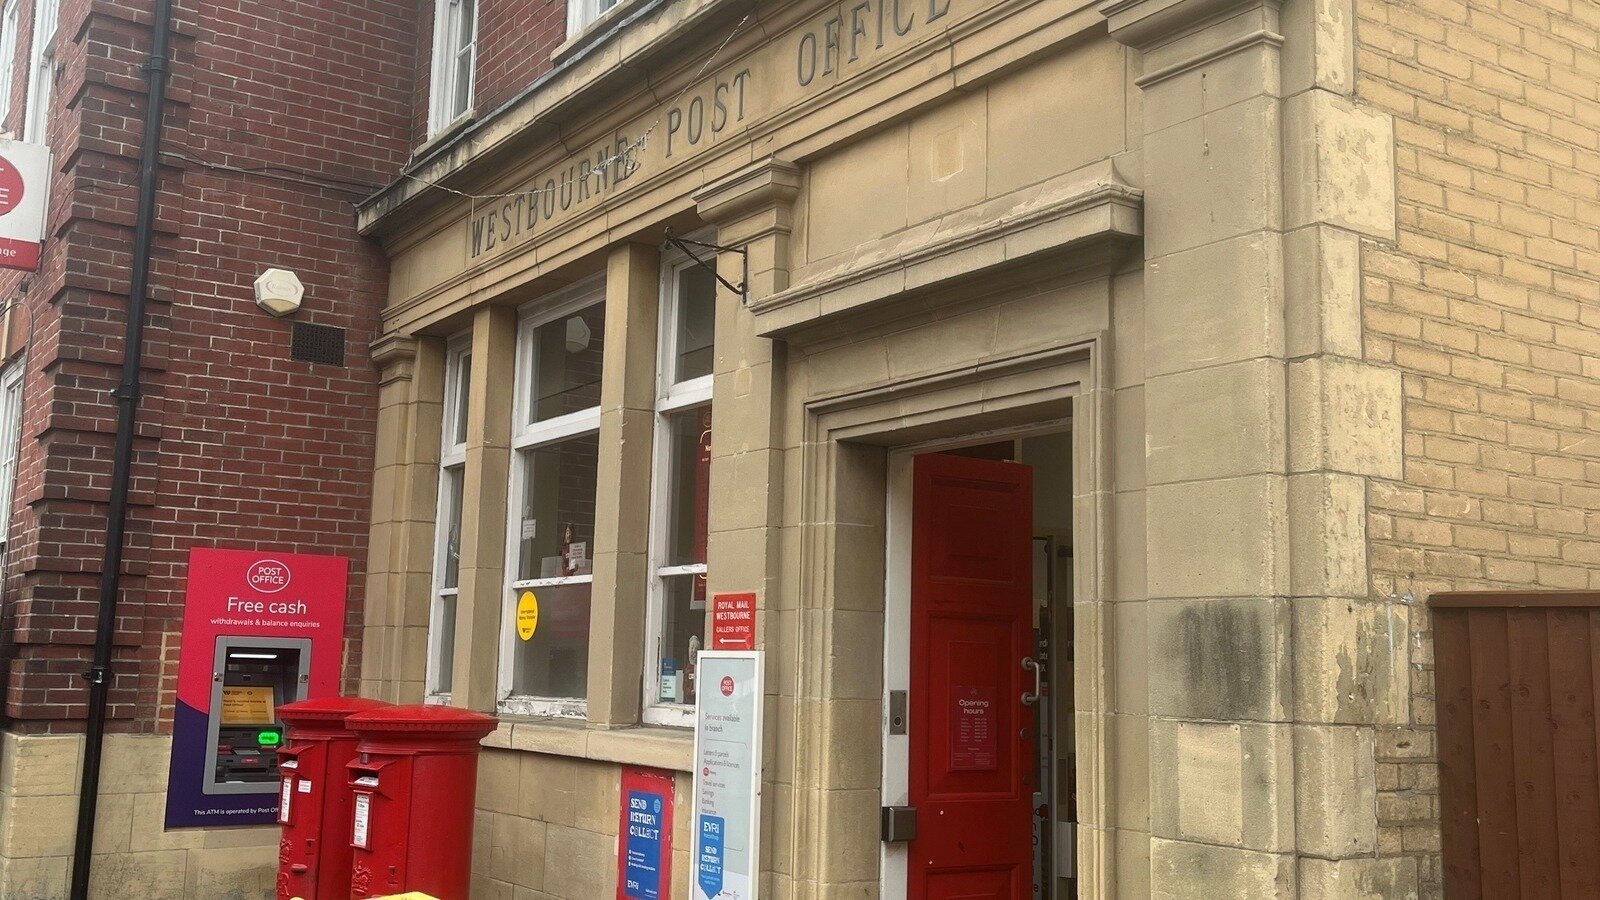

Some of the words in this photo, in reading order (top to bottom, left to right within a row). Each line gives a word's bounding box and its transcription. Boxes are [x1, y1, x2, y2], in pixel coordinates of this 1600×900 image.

[471, 136, 632, 258] WESTBOURNE
[665, 68, 752, 158] POST
[258, 567, 282, 576] POST
[252, 576, 284, 584] OFFICE
[227, 596, 264, 613] Free
[269, 600, 307, 614] cash
[717, 601, 735, 609] ROYAL
[736, 600, 749, 608] MAIL
[716, 611, 751, 620] WESTBOURNE
[210, 618, 254, 626] withdrawals
[262, 619, 289, 627] balance
[735, 625, 750, 633] OFFICE
[958, 700, 989, 708] Opening
[704, 712, 721, 721] Services
[630, 798, 647, 810] SEND
[630, 811, 656, 825] RETURN
[630, 826, 660, 840] COLLECT
[704, 846, 717, 854] SEND
[700, 863, 721, 874] COLLECT
